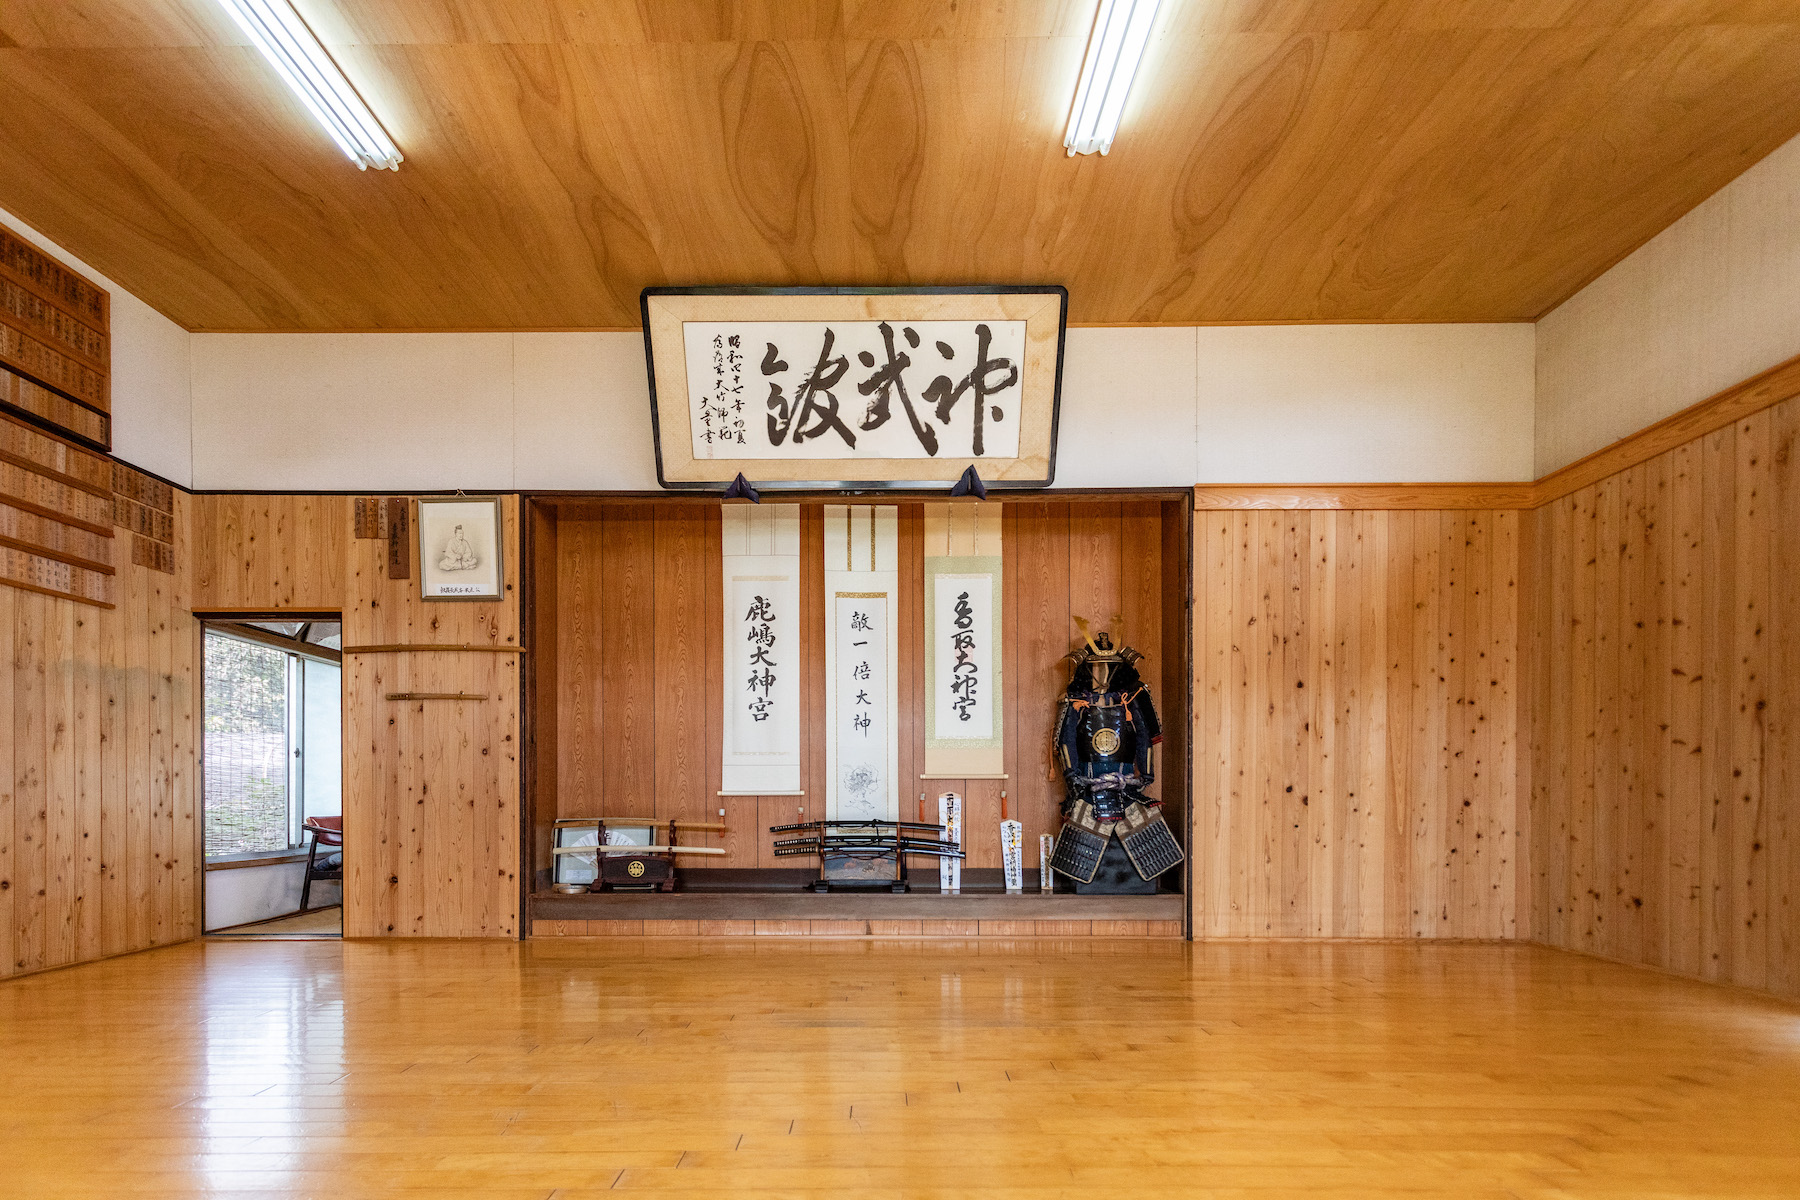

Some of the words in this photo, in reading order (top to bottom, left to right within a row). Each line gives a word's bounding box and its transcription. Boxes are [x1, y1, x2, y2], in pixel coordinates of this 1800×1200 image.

[744, 595, 777, 722] 鹿嶋大神宮
[851, 611, 873, 738] 敵一倍大神
[950, 591, 978, 721] 香取大神宮
